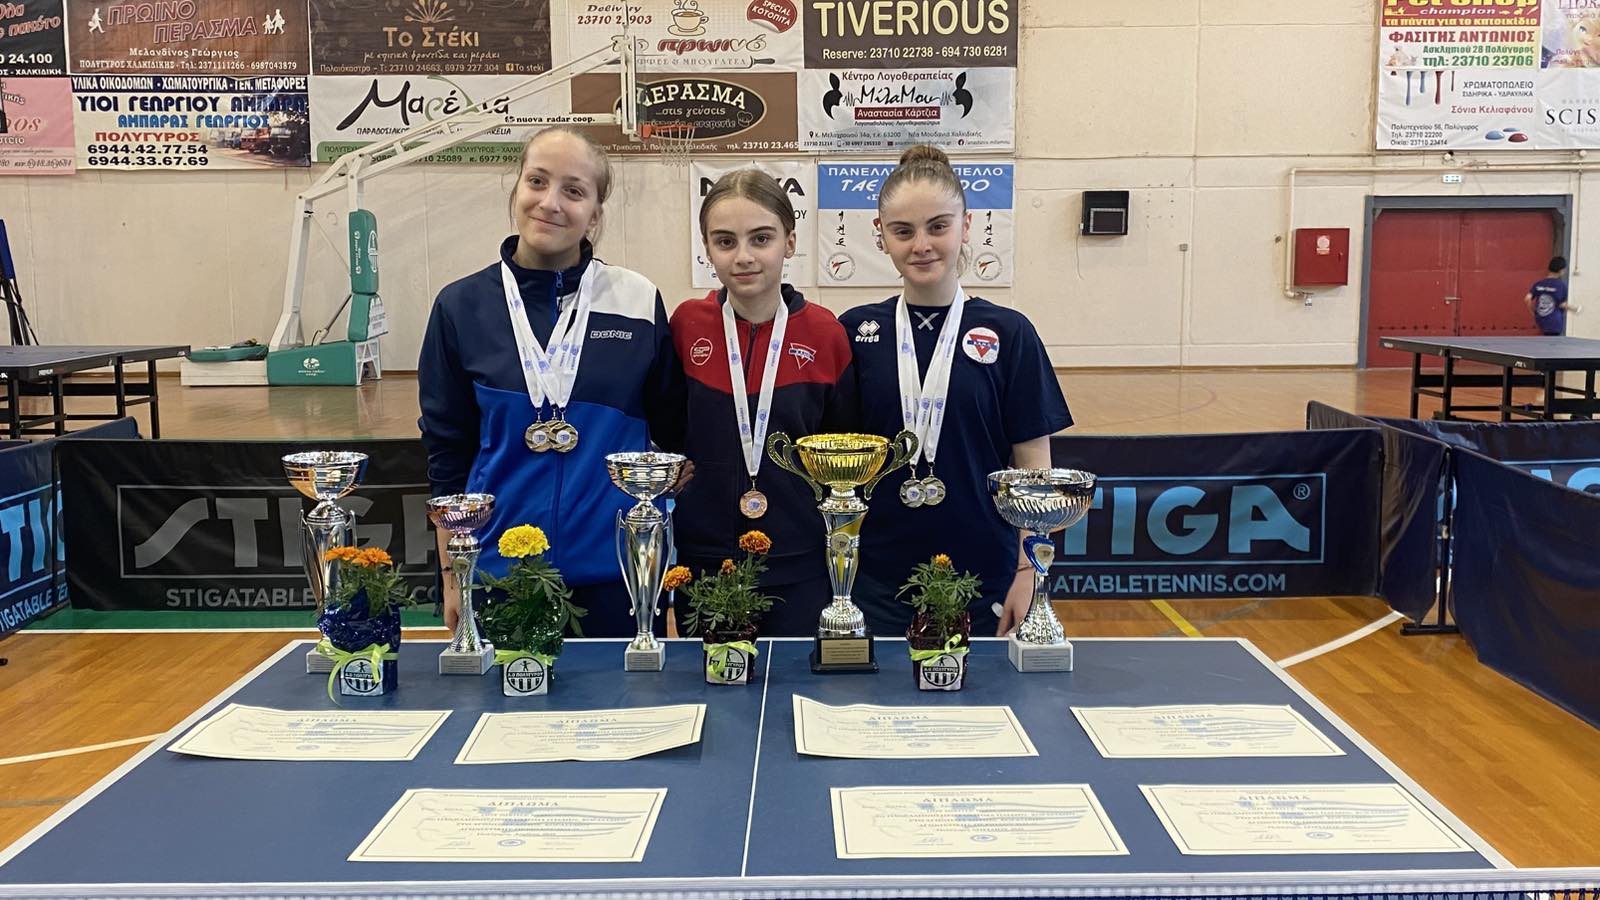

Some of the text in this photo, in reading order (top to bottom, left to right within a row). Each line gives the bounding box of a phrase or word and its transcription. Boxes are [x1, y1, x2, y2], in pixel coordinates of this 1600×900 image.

[107, 0, 196, 25] ΠΡΩΙΝΟ
[587, 5, 642, 13] Delivry
[762, 0, 790, 16] SPECIAL
[1420, 7, 1496, 15] champion
[577, 16, 612, 24] 23710
[751, 5, 791, 26] ΚΟΤΟΠΙΤΑ
[813, 0, 1010, 37] TIVERIOUS
[153, 16, 257, 43] ΠΕΡΑΣΜΑ
[1388, 31, 1535, 42] ΦΑΣΙΤΗΣ ΑΝΤΩΝΙΟΣ
[191, 48, 240, 59] Γεώργιος
[823, 46, 1008, 59] Reserve: 23710 22738 694 730 6281
[8, 53, 53, 64] 24.100
[1452, 56, 1489, 66] 23710
[1493, 56, 1534, 66] 23706
[389, 64, 414, 72] 23710
[842, 70, 953, 82] Κέντρο Λογοθεραπείας
[73, 77, 98, 89] ΥΛΙΚΑ
[100, 77, 153, 89] ΟΙΚΟΔΟΜΩΝ
[255, 77, 306, 90] ΜΕΤΑΦΟΡΕΣ
[1463, 81, 1534, 89] ΧΡΩΜΑΤΟΠΩΛΕΙΟ
[77, 96, 118, 111] ΥΙΟΙ
[129, 96, 220, 111] ΓΕΩΡΓΙΟΥ
[857, 109, 938, 119] Αναστασία Κάρτζια
[1451, 105, 1477, 114] Σόνια
[118, 115, 269, 128] ΑΜΠΑΡΑΣ ΓΕΩΡΓΙΟΣ
[573, 116, 596, 124] coop.
[95, 132, 199, 141] ΠΟΛΥΓΥΡΟΣ
[88, 144, 208, 154] 6944.42.77.54
[743, 141, 769, 149] 23710
[771, 141, 799, 149] 23.465
[89, 156, 208, 166] 6944.33.67.69
[591, 330, 632, 340] DONIC
[1063, 485, 1310, 555] TIGA
[1053, 574, 1286, 593] ATABLETENNIS.COM
